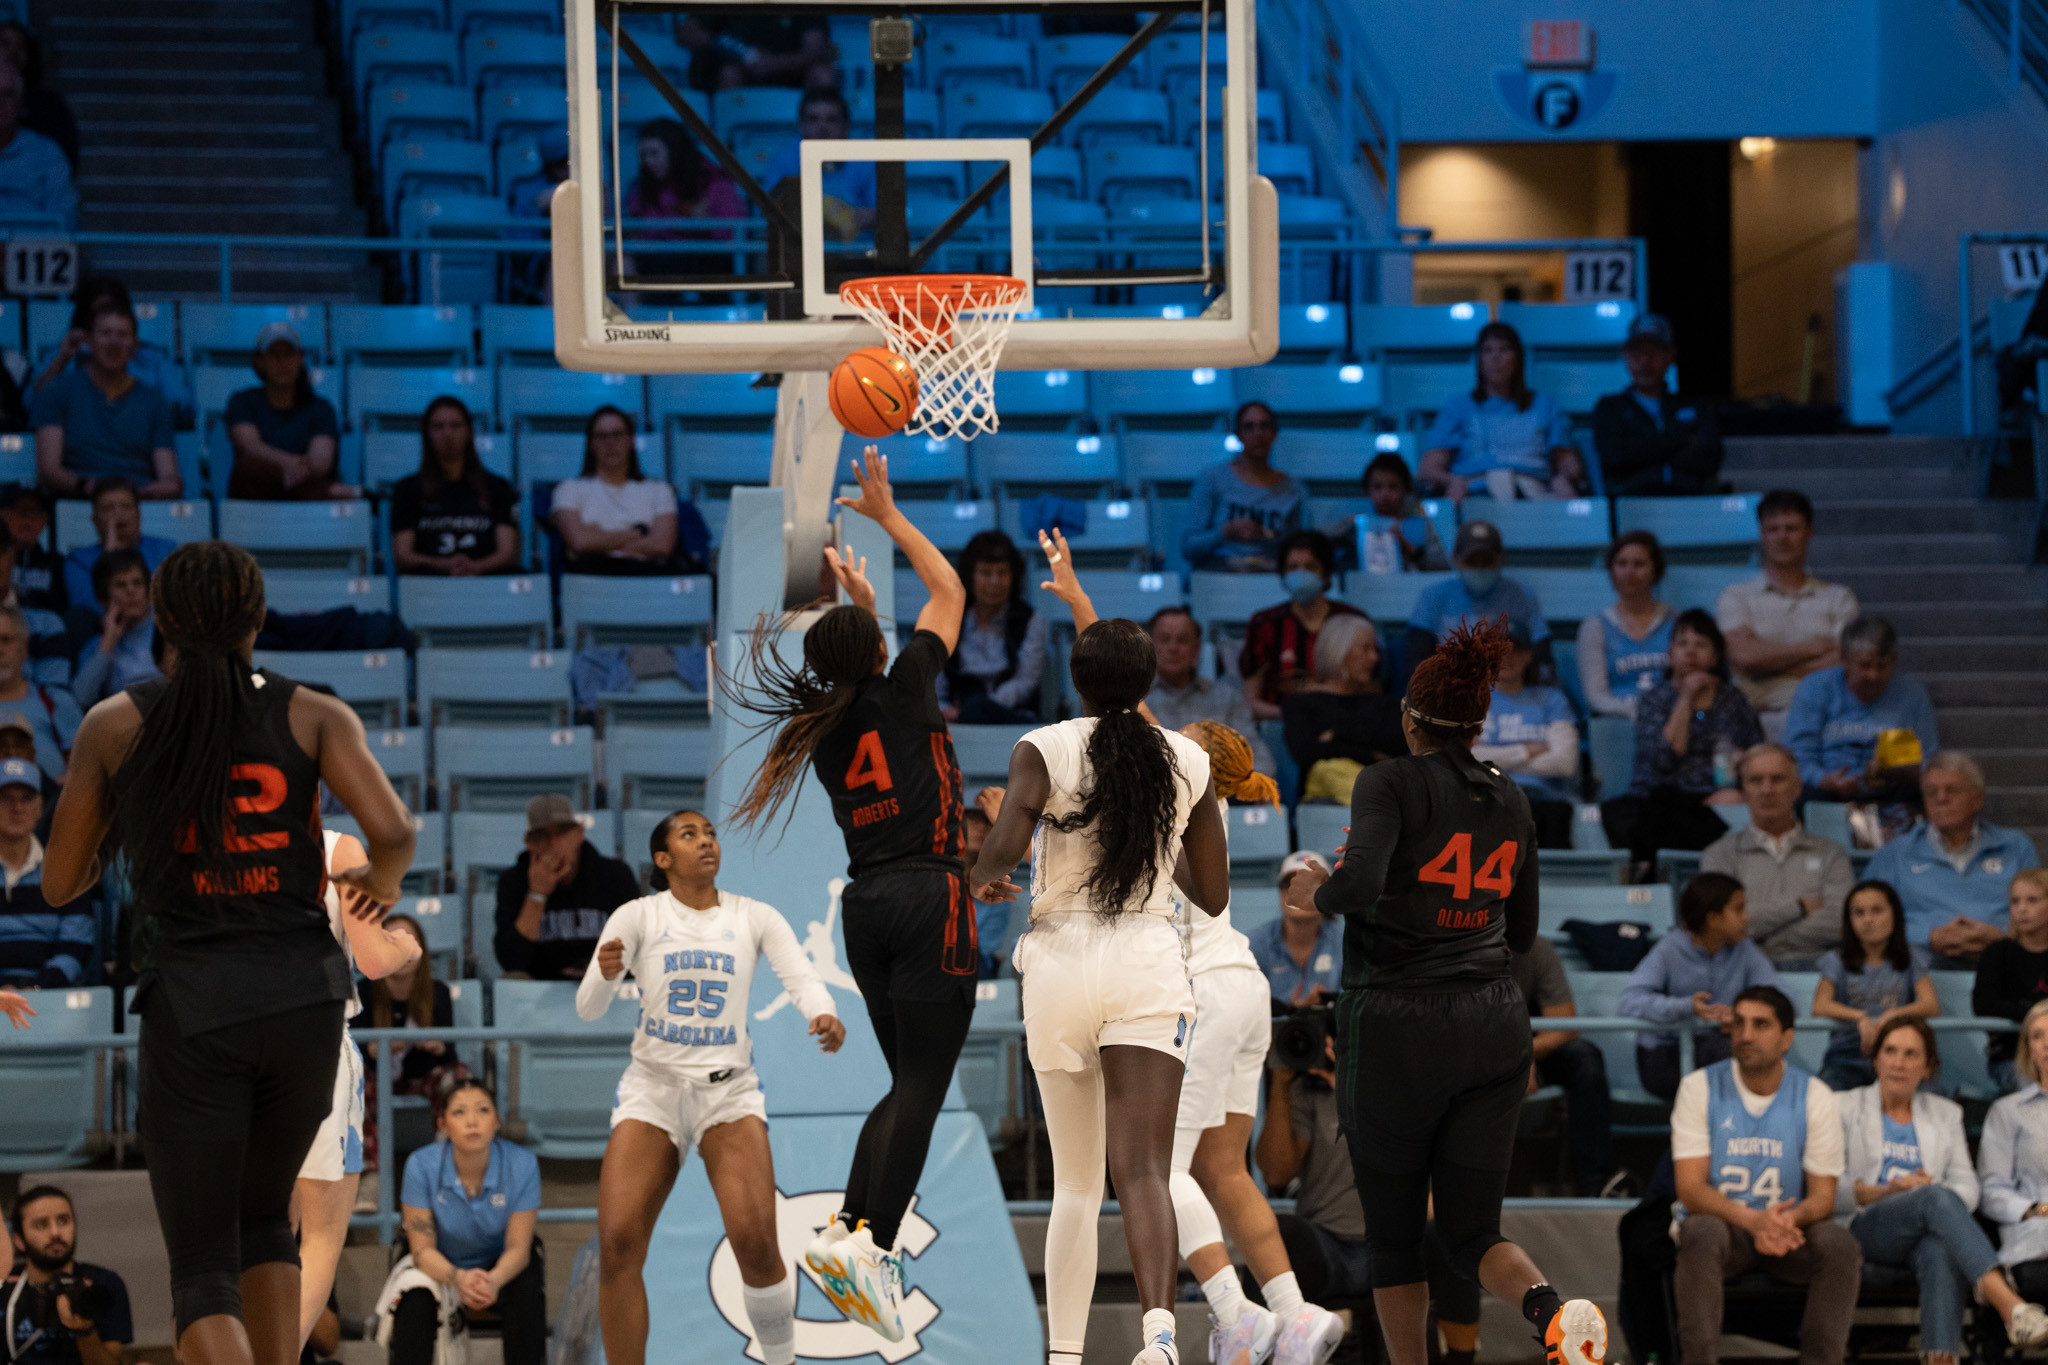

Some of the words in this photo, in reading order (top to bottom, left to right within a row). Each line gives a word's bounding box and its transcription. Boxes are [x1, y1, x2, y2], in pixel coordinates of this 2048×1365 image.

[1544, 88, 1572, 126] F
[17, 249, 71, 284] 112
[1575, 260, 1625, 294] 112
[605, 326, 671, 343] SPALDING
[844, 730, 893, 792] 4
[852, 798, 900, 828] ROBERTS
[1418, 832, 1518, 900] 44
[1437, 908, 1490, 928] OLDACRE
[664, 949, 735, 975] NORTH
[668, 979, 728, 1017] 25
[644, 1017, 737, 1046] CAROLINA
[1726, 1136, 1783, 1159] NORTH
[1718, 1164, 1783, 1209] 24
